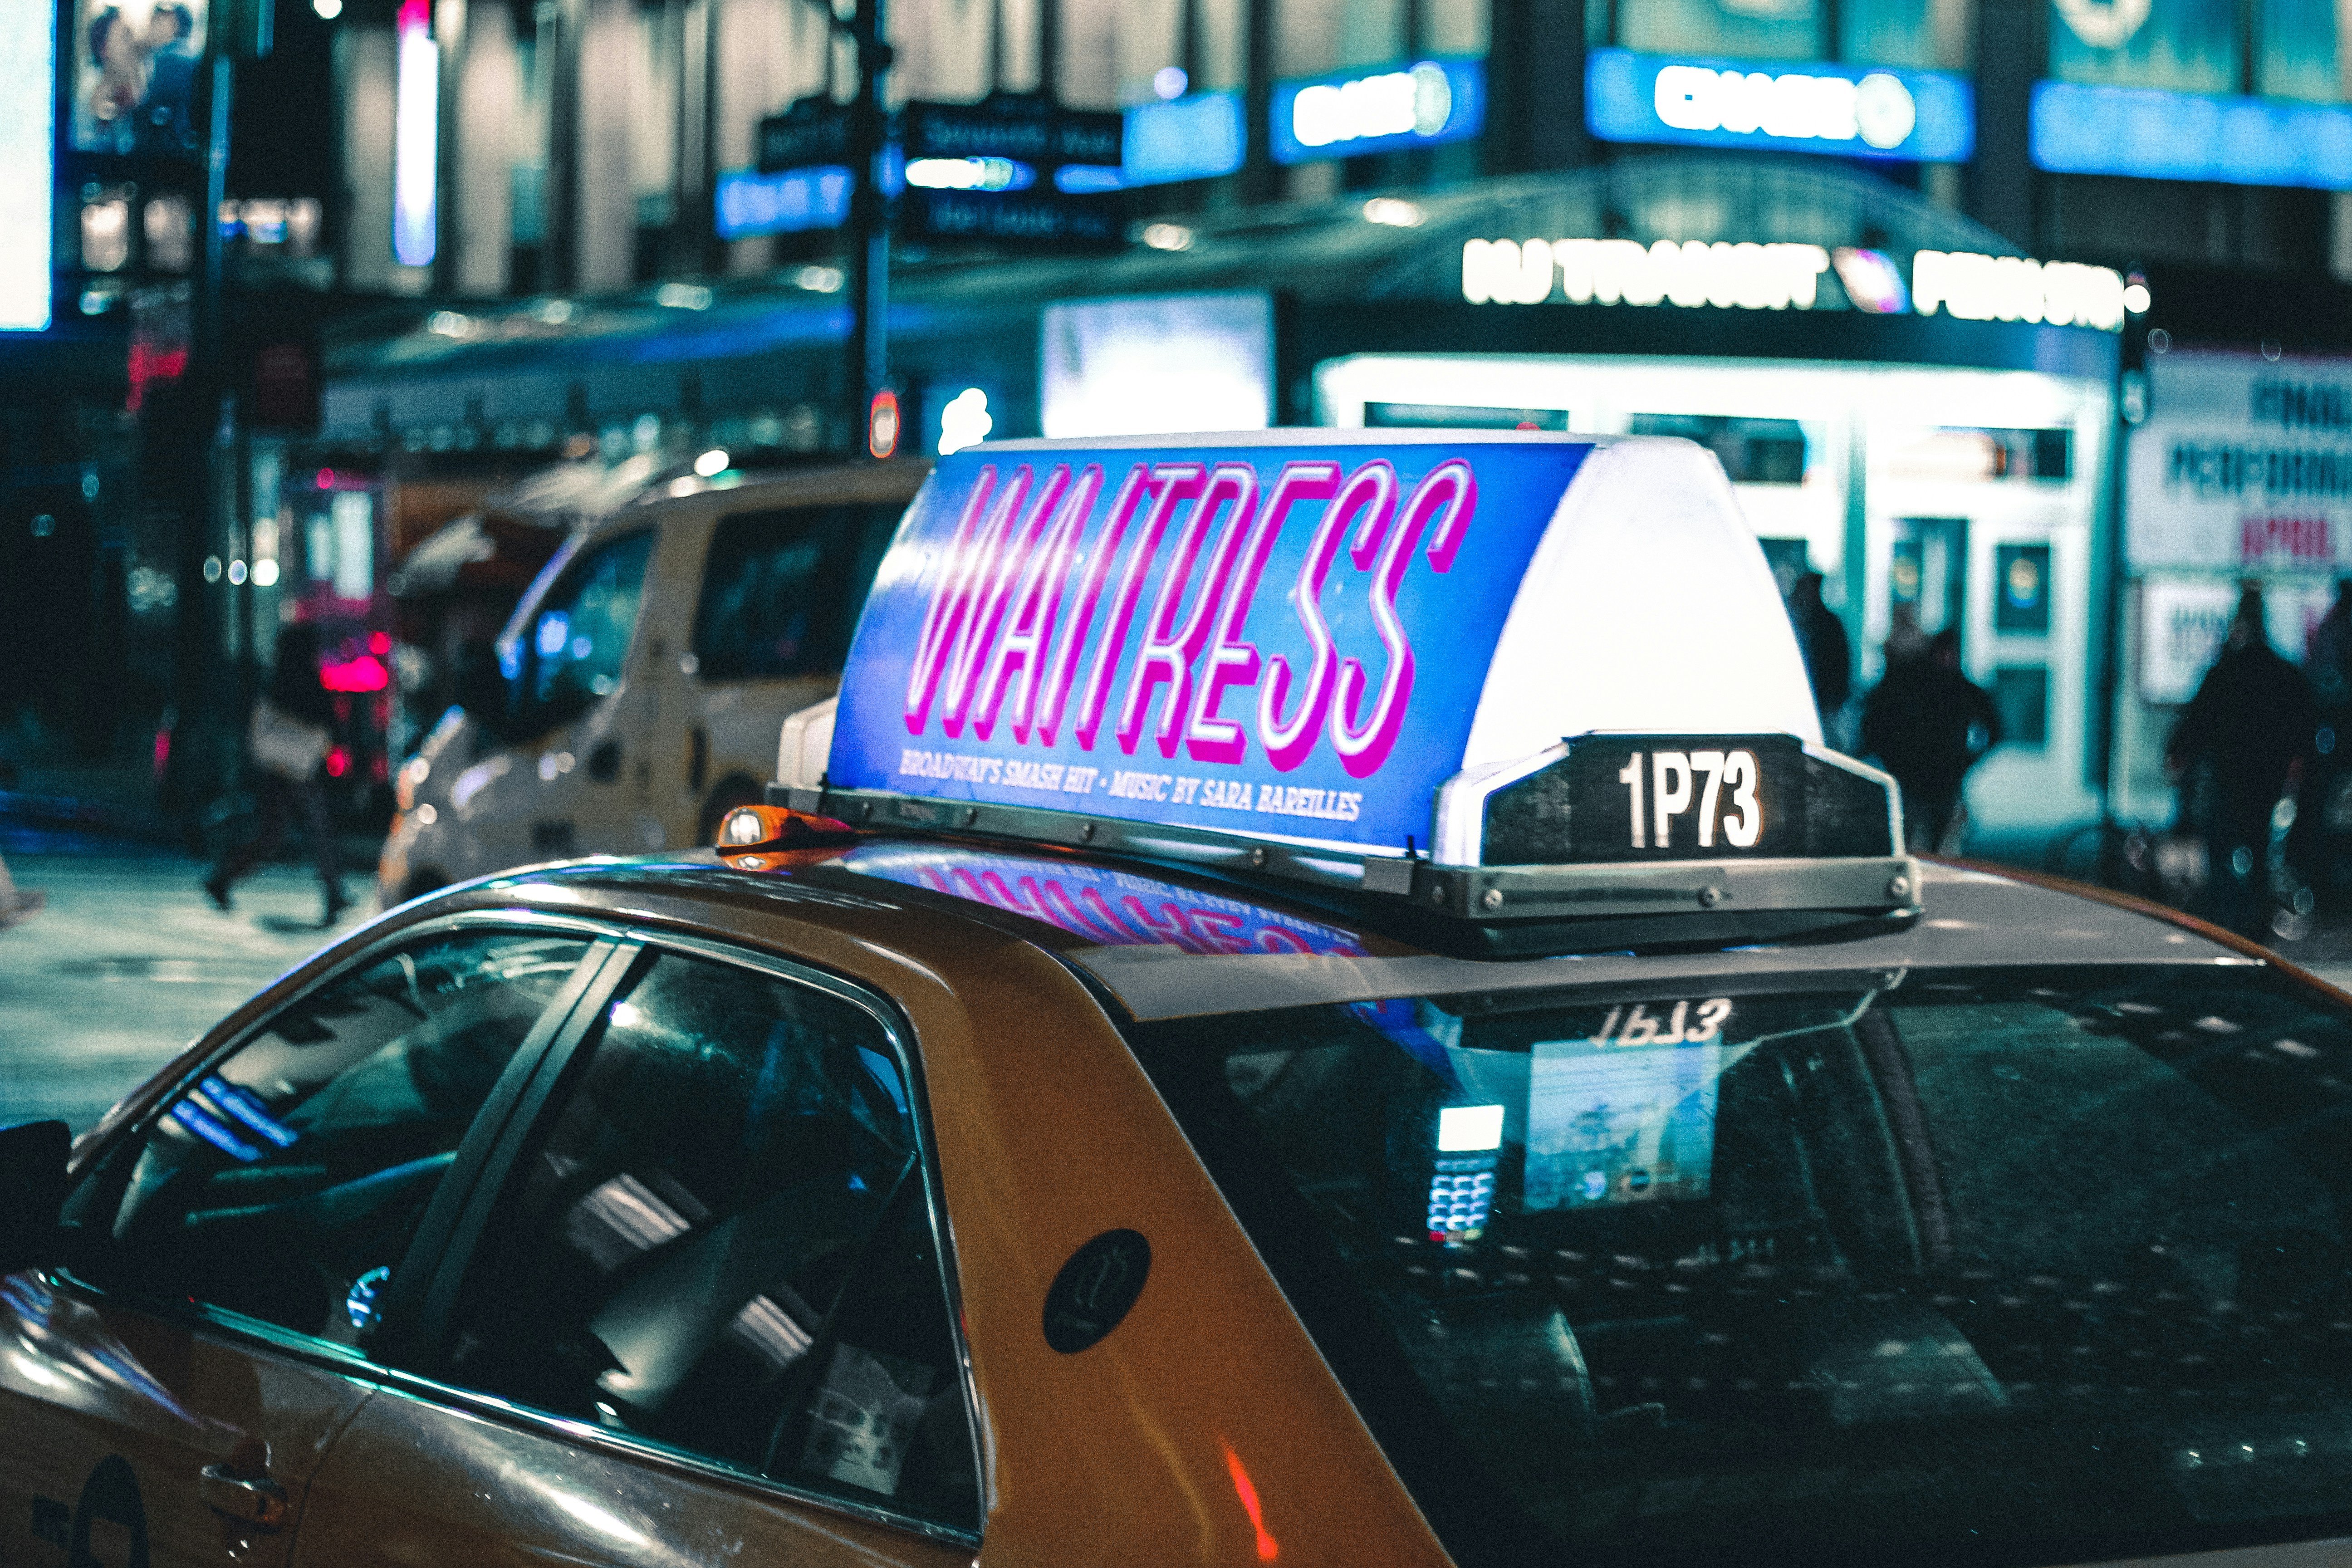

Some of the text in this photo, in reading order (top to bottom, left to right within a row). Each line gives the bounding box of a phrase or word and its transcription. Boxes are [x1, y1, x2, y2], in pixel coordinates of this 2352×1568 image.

[905, 458, 1478, 778] WAITRESS
[898, 750, 1363, 822] BROADWAY'S SMASH HIT MUSIC BY SARA BAREILLES
[1618, 749, 1763, 848] 1P73
